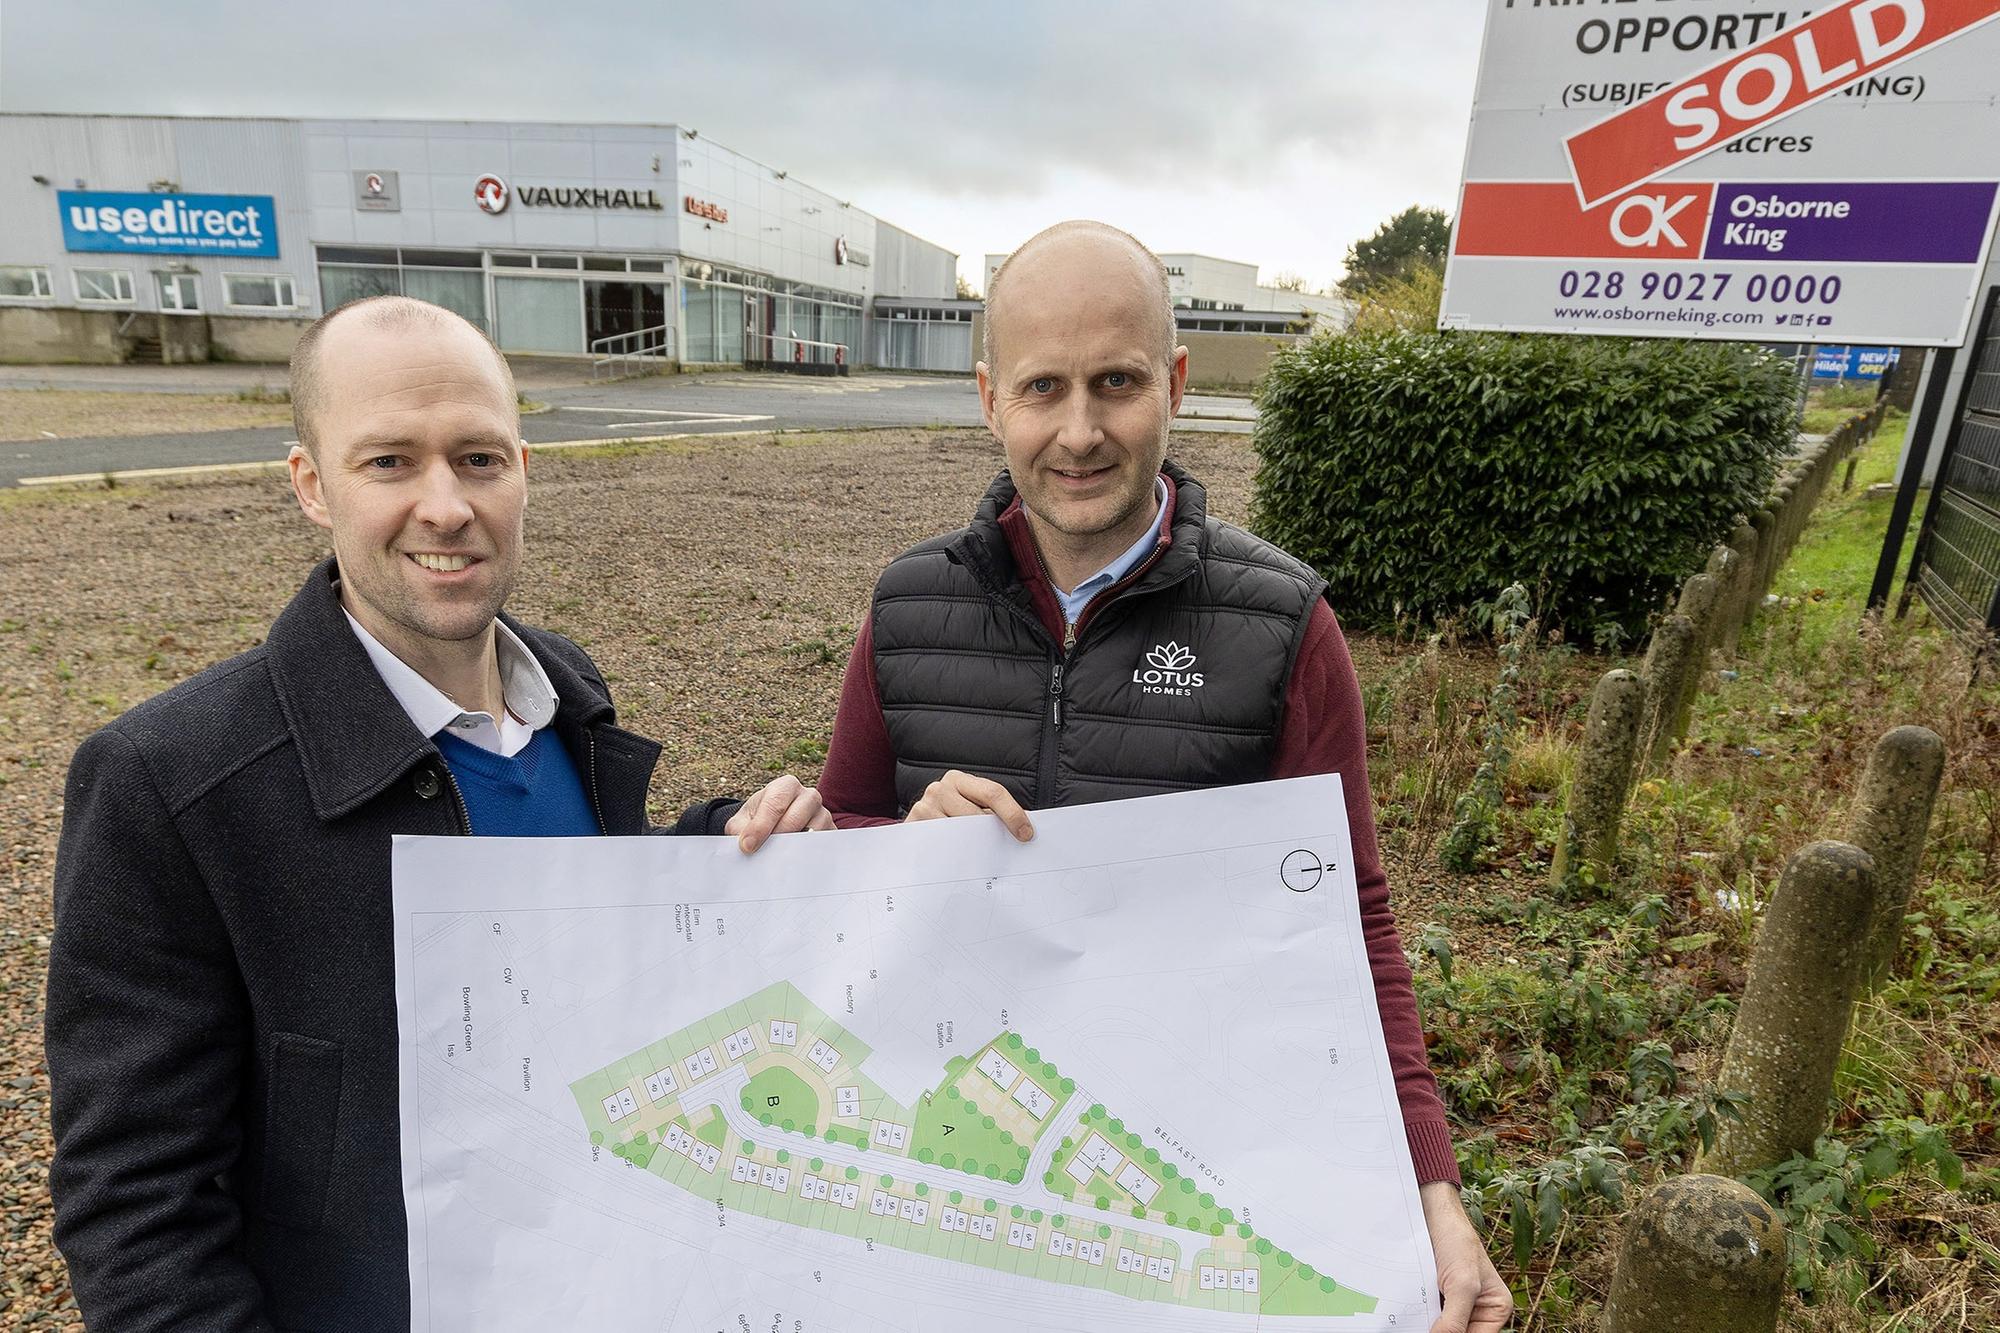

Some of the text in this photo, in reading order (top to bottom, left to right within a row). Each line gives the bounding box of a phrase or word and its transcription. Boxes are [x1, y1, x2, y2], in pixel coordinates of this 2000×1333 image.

[1665, 0, 1926, 151] SOLD
[517, 186, 664, 211] VAUXHALL
[1730, 195, 1850, 218] Osborne
[69, 199, 262, 237] usedirect
[1723, 223, 1788, 252] King
[1560, 270, 1842, 304] 028 9027 0000
[1554, 305, 1764, 327] www.osborneking.com
[1133, 669, 1204, 687] LOTUS
[1143, 685, 1192, 696] HOMES
[492, 922, 501, 936] CF
[503, 967, 512, 985] CW
[846, 984, 854, 1015] Rectory
[462, 986, 473, 1052] Bowling Green
[936, 1022, 944, 1049] Station
[522, 1057, 531, 1092] Pavilion
[767, 1095, 780, 1107] B
[942, 1124, 955, 1136] A
[1154, 1126, 1225, 1187] BELFAST ROAD
[716, 1198, 724, 1212] MP
[813, 1270, 822, 1283] SP
[738, 1313, 746, 1325] 68
[774, 1312, 782, 1324] 64
[794, 1319, 802, 1331] 60
